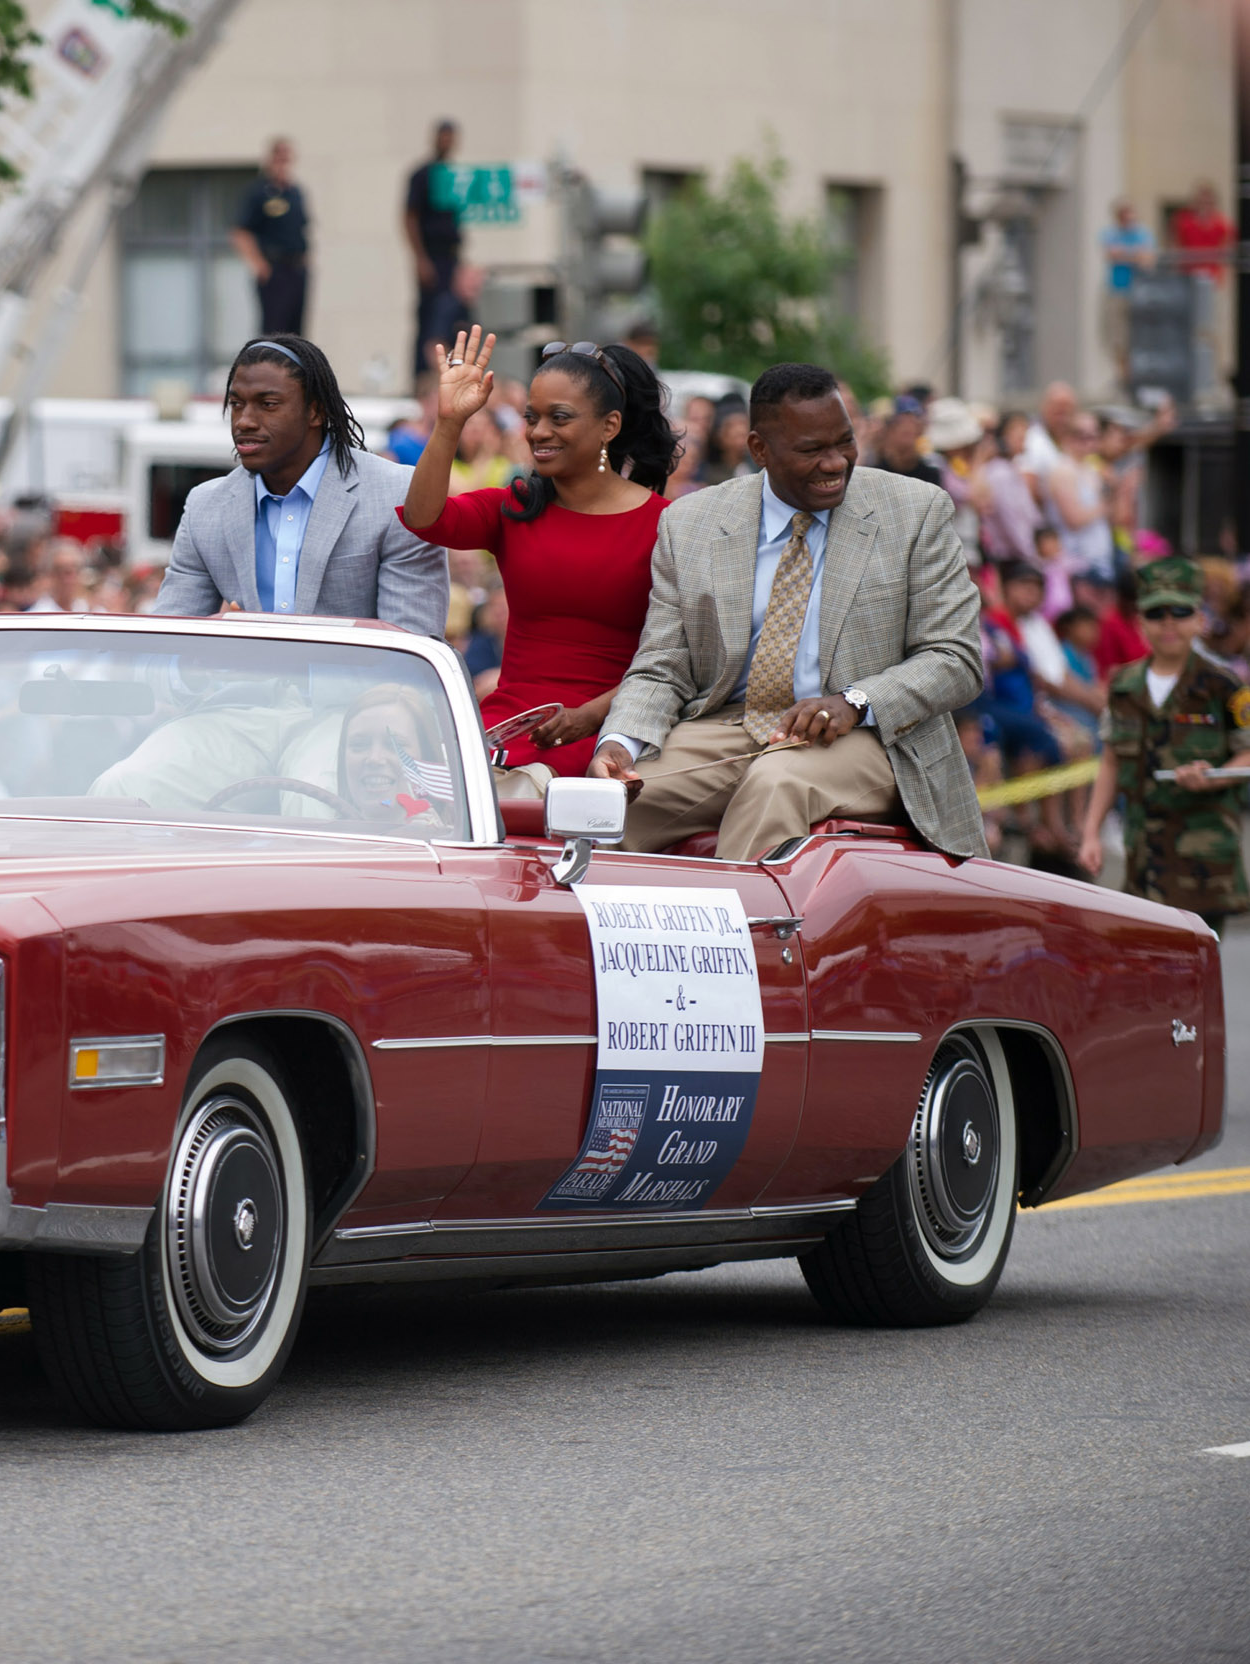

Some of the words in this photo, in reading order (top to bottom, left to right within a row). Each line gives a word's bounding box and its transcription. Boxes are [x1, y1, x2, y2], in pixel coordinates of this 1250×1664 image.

[590, 901, 653, 930] ROBERT
[653, 903, 714, 932] GRIFFIN
[599, 942, 690, 978] JACQUELINE
[691, 945, 754, 981] GRIFFIN,
[607, 1021, 669, 1051] ROBERT
[674, 1022, 736, 1052] GRIFFIN
[740, 1025, 757, 1053] III
[598, 1100, 644, 1117] NATIONAL
[656, 1085, 745, 1122] HONORARY
[656, 1130, 718, 1165] GRAND
[560, 1172, 617, 1190] PARADE
[614, 1172, 710, 1201] MARSHALS
